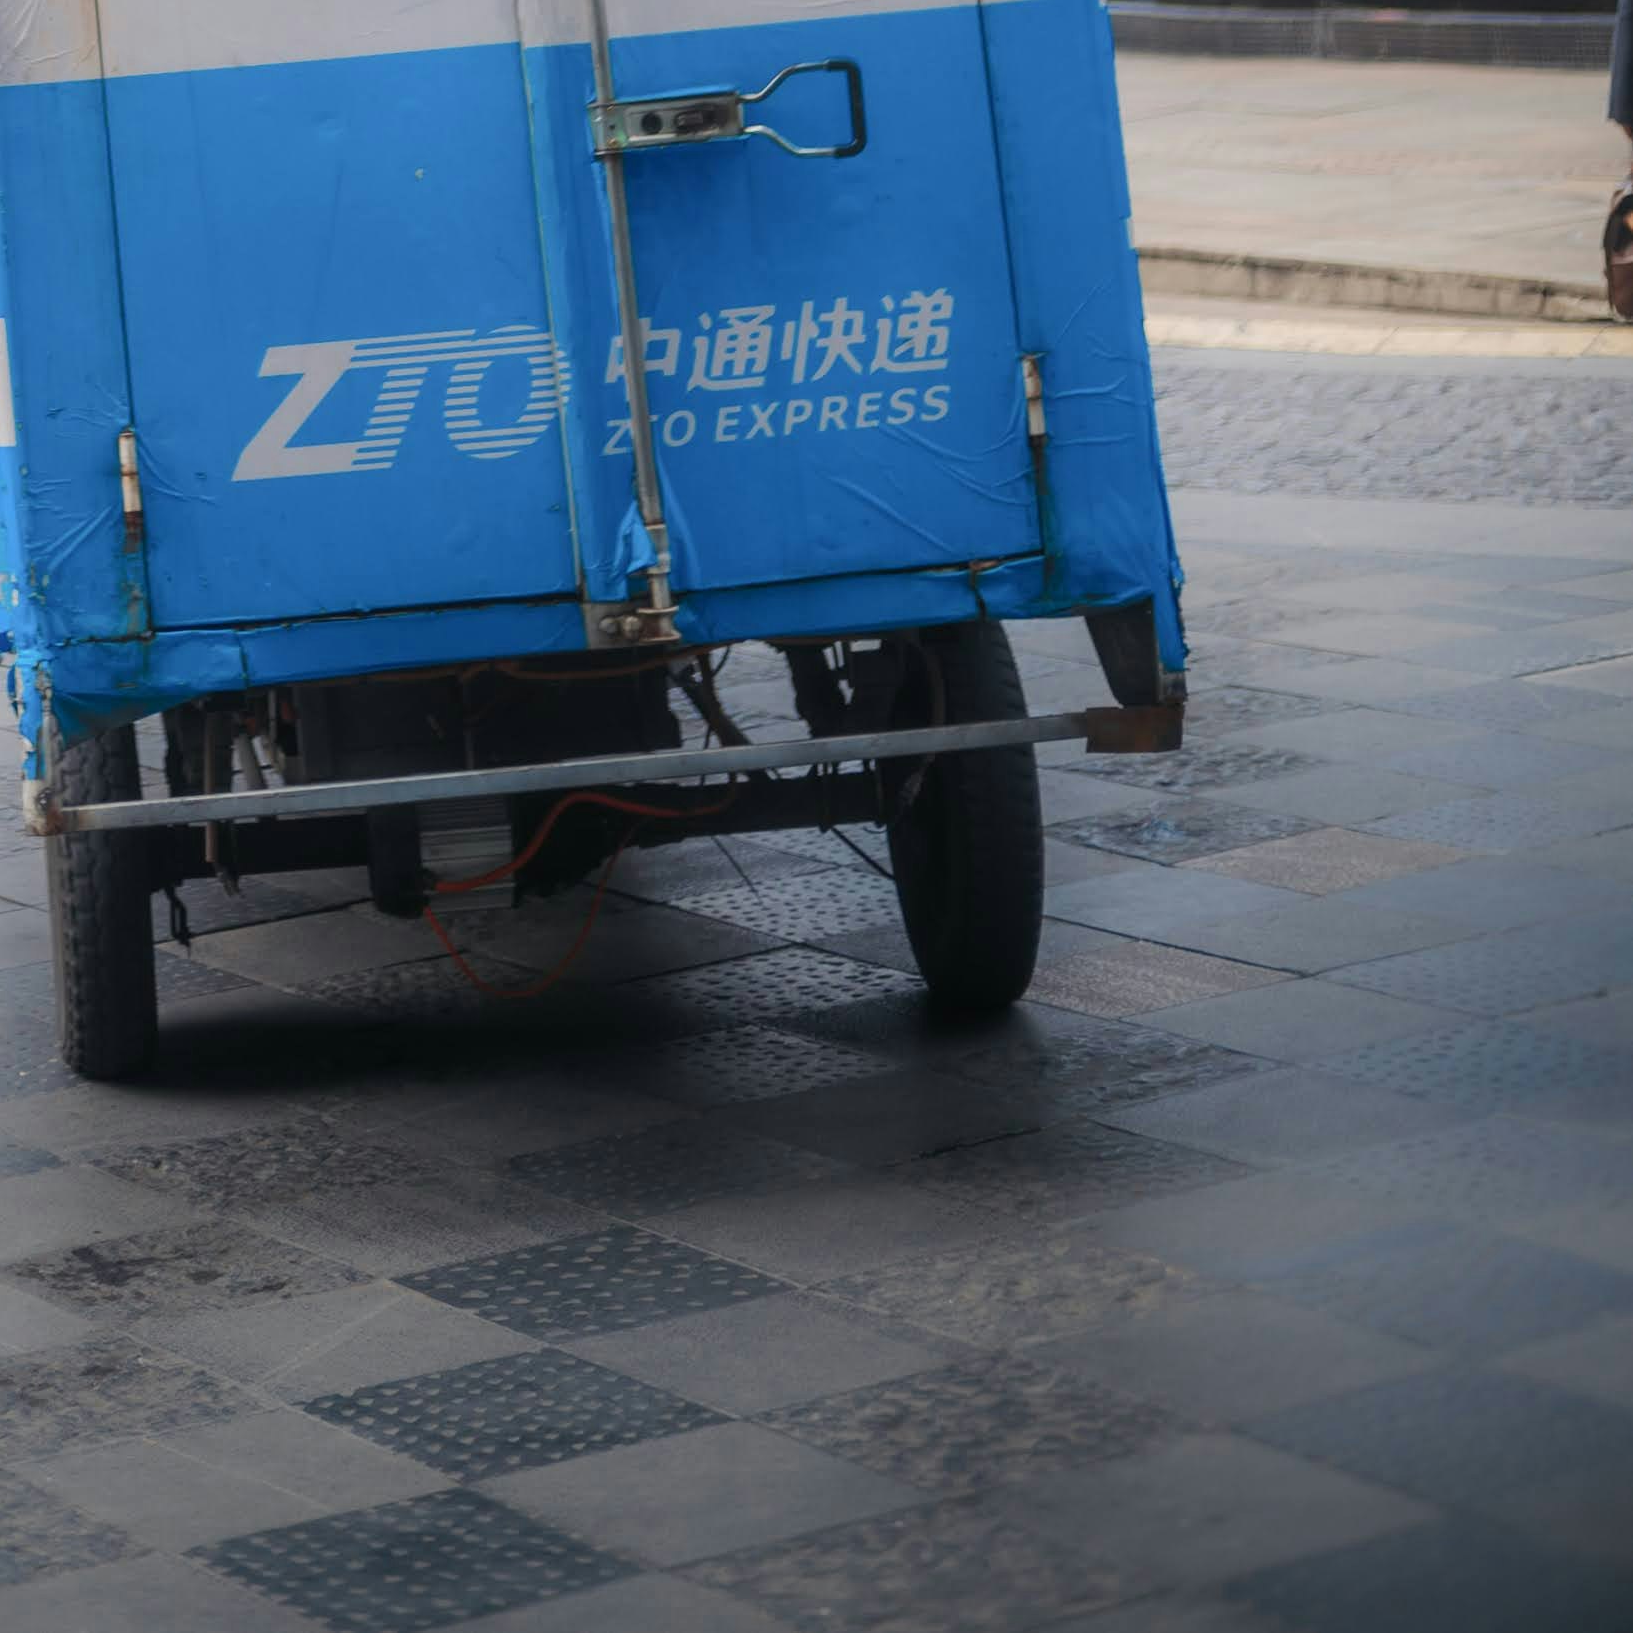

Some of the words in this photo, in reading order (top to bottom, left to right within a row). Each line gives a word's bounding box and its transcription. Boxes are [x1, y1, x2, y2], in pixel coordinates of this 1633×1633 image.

[231, 324, 572, 482] ZTO
[601, 409, 697, 457] ZO
[714, 384, 952, 443] EXPRESS
